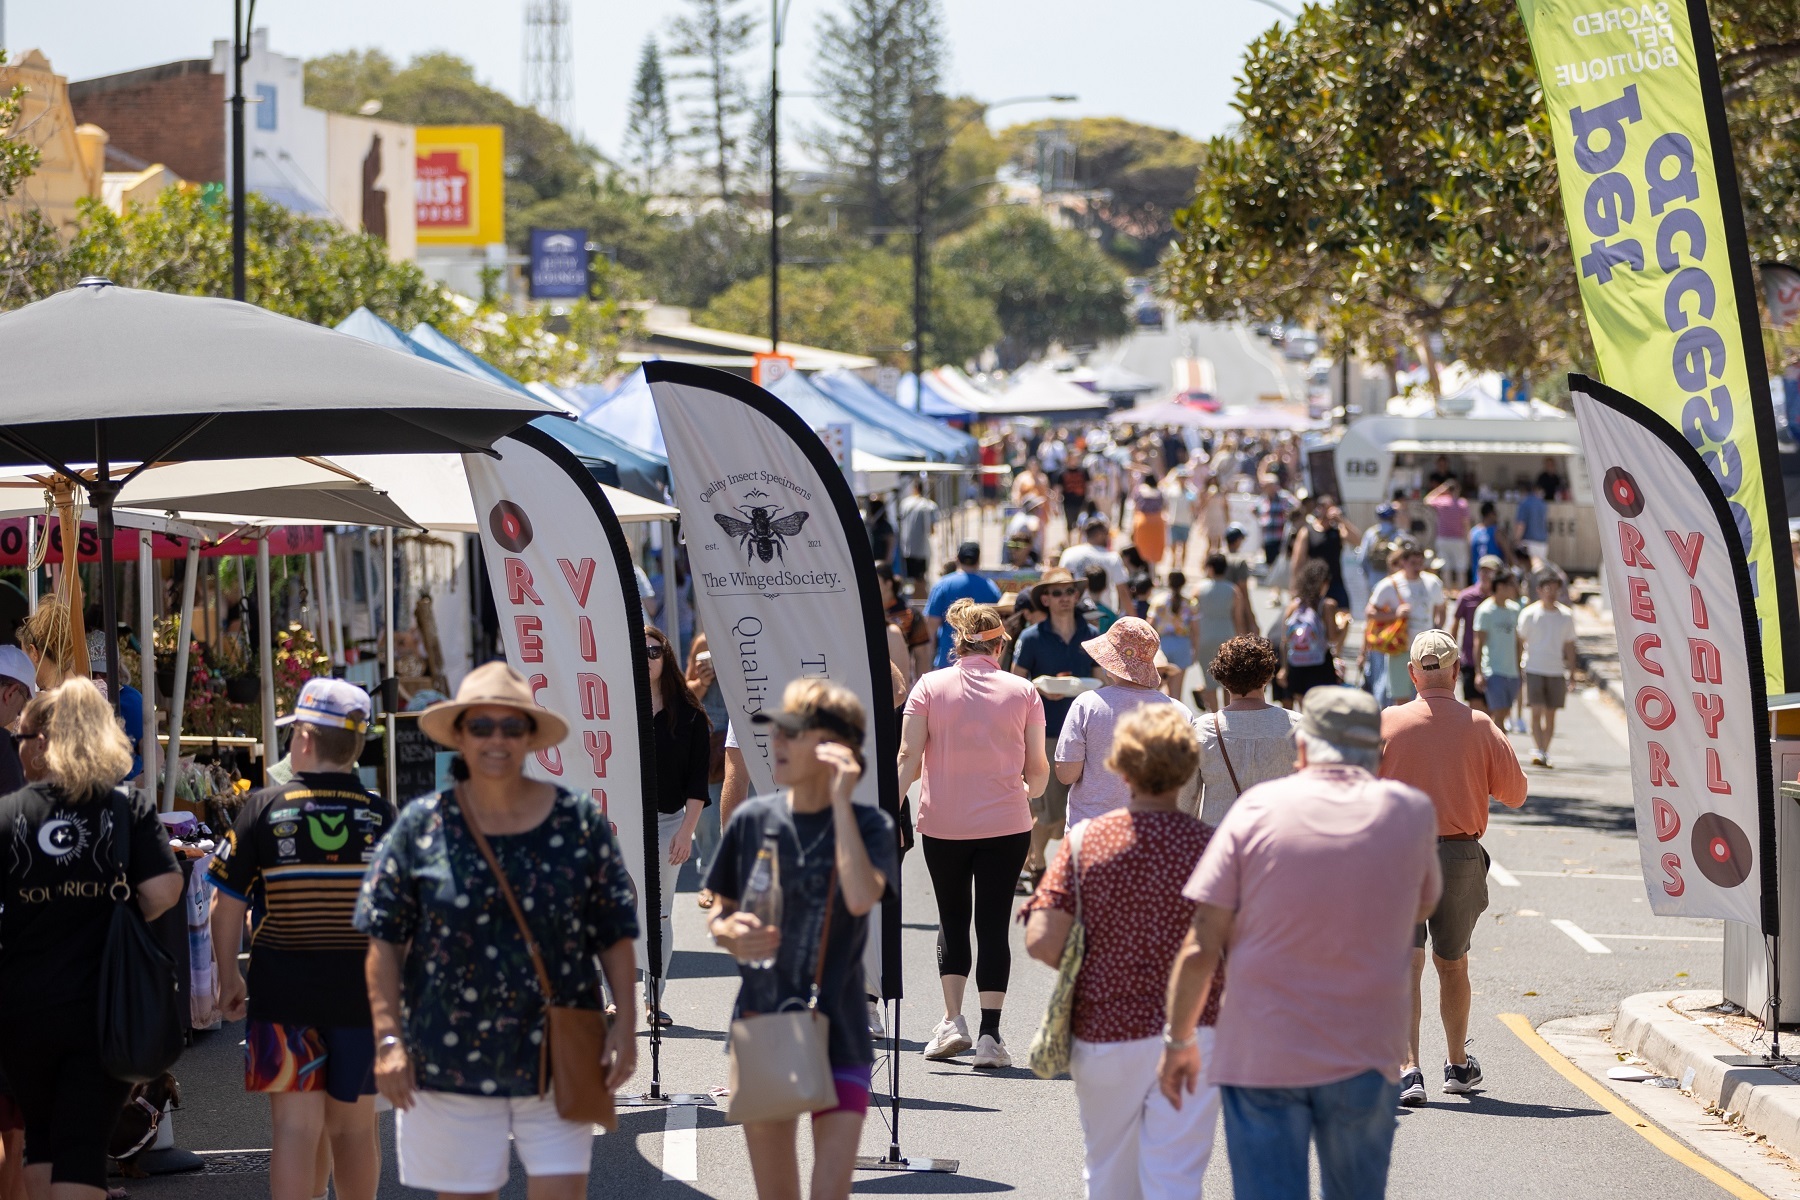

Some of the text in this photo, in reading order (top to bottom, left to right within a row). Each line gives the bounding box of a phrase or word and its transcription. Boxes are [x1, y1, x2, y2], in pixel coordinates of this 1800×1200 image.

[700, 470, 812, 503] Quality Insect Specimens
[704, 543, 720, 551] est.
[807, 540, 822, 548] 2021
[702, 570, 841, 590] The WingedSociety.
[731, 616, 769, 717] Quality
[1665, 530, 1733, 796] VINYL
[1617, 520, 1685, 898] RECORDS
